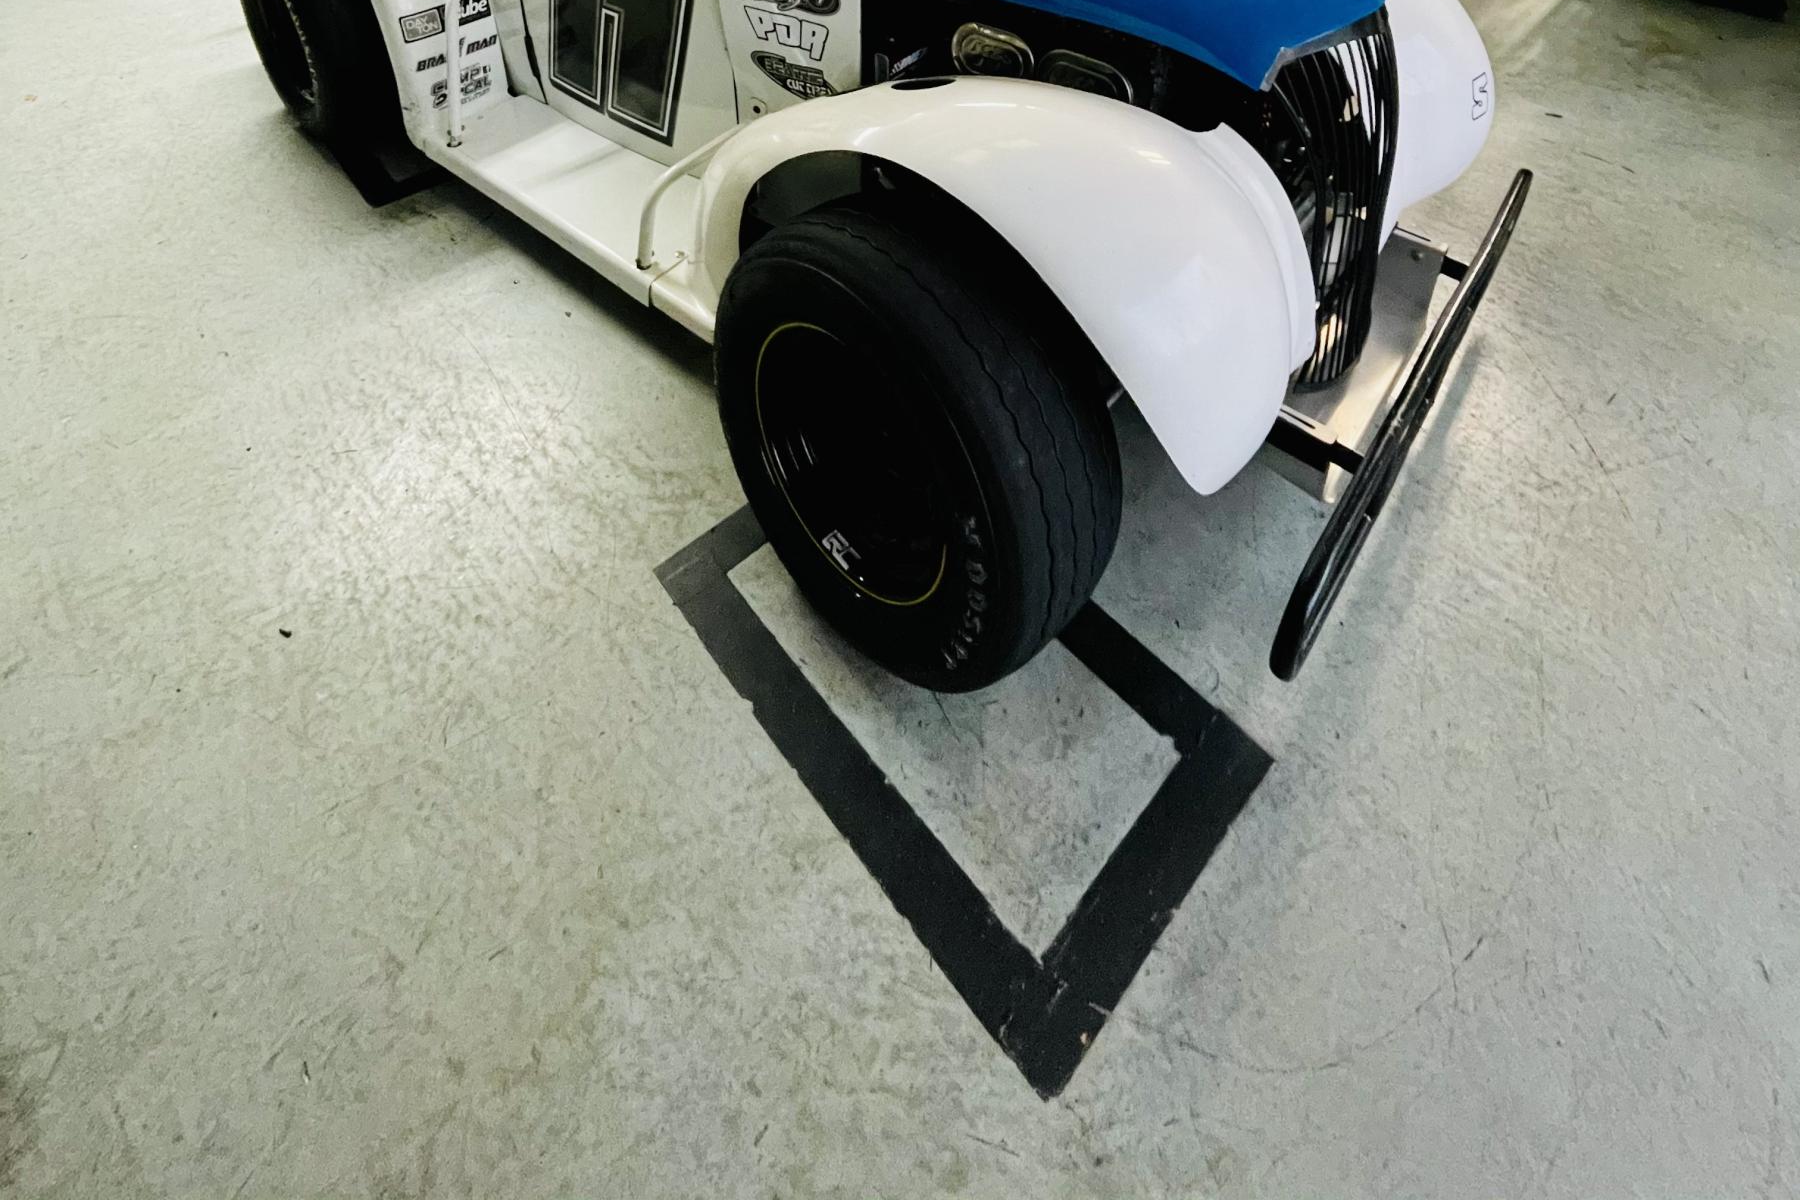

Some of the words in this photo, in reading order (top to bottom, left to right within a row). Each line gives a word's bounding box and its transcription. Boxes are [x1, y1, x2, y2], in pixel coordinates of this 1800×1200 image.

[405, 15, 428, 30] DAY
[418, 21, 438, 34] TON
[744, 6, 829, 61] PDR
